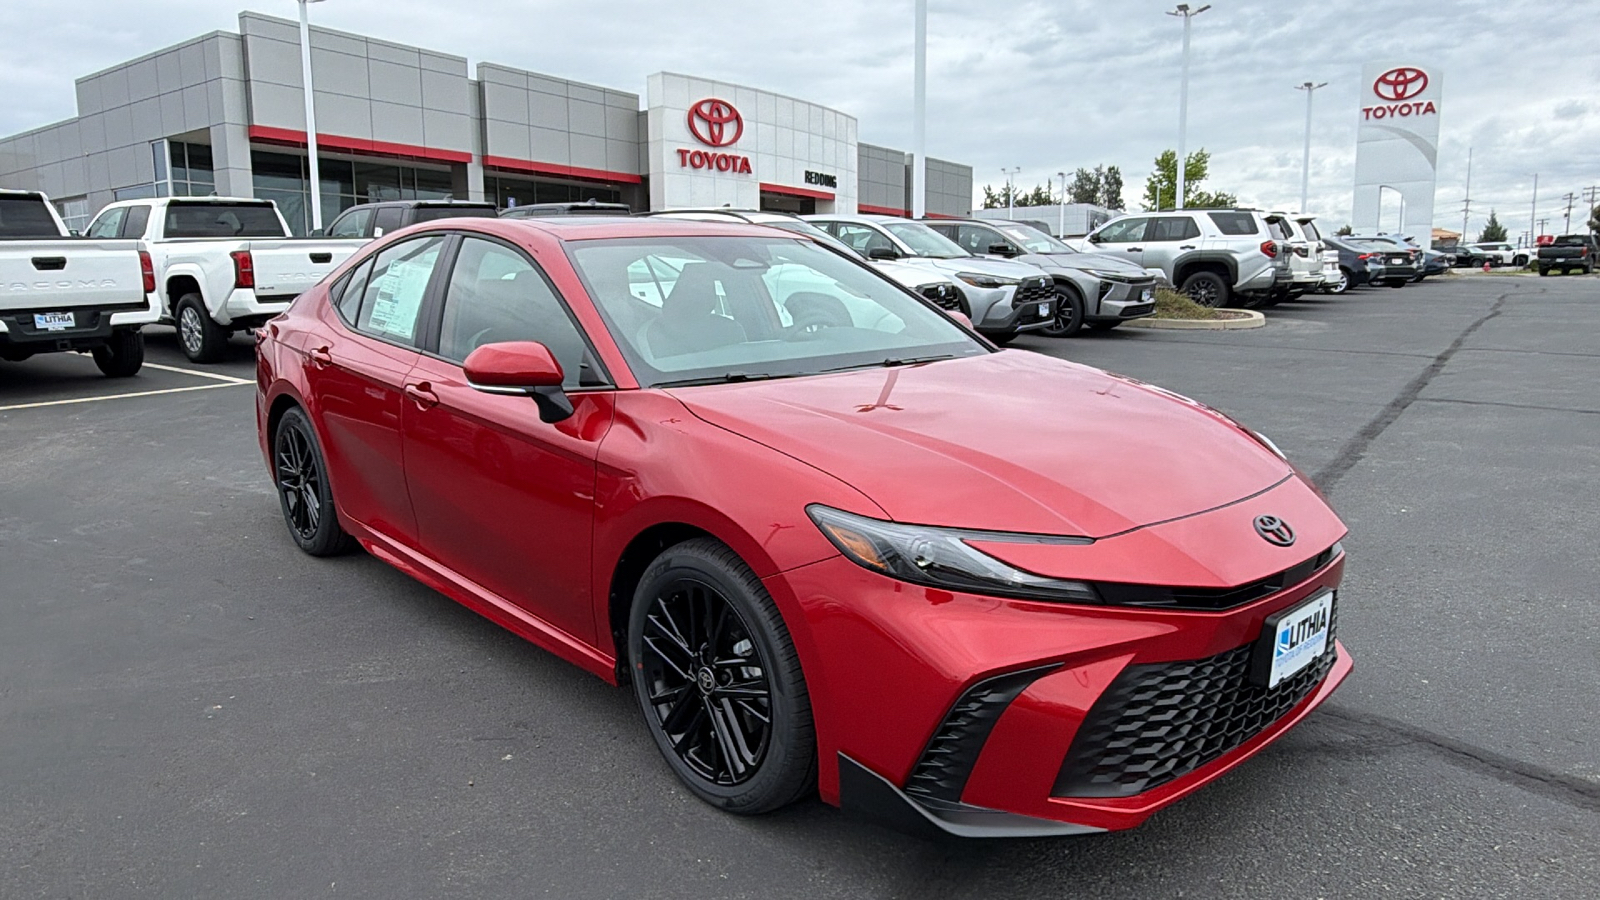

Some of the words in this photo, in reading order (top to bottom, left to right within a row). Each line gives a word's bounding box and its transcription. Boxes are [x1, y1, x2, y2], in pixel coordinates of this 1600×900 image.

[1362, 102, 1436, 120] TOYOTA
[677, 149, 752, 174] TOYOTA
[805, 170, 837, 188] REDDING
[278, 272, 329, 280] TAC
[44, 315, 72, 323] LITHIA
[1289, 607, 1326, 650] LITHIA
